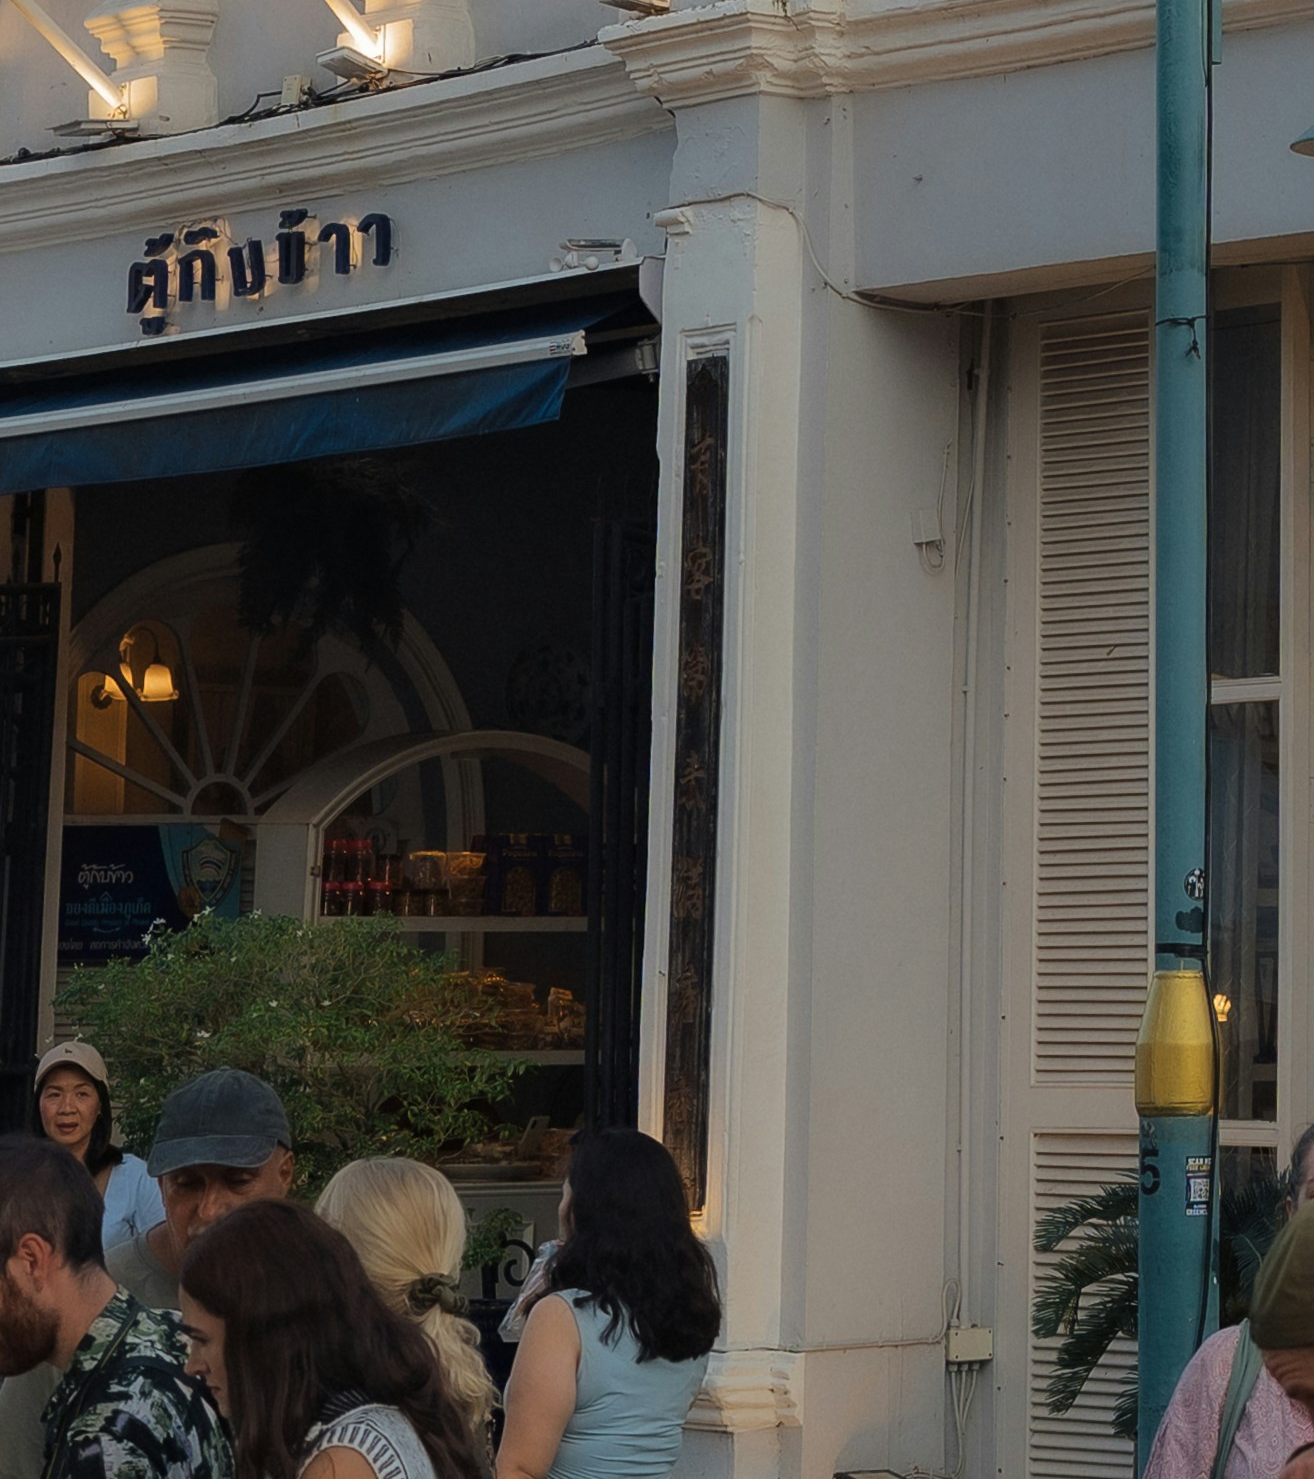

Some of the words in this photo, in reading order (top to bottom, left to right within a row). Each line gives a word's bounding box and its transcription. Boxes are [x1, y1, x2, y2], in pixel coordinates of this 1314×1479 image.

[127, 208, 391, 335] ตู้กับข้าว
[77, 863, 134, 890] ตู้กับข้าว
